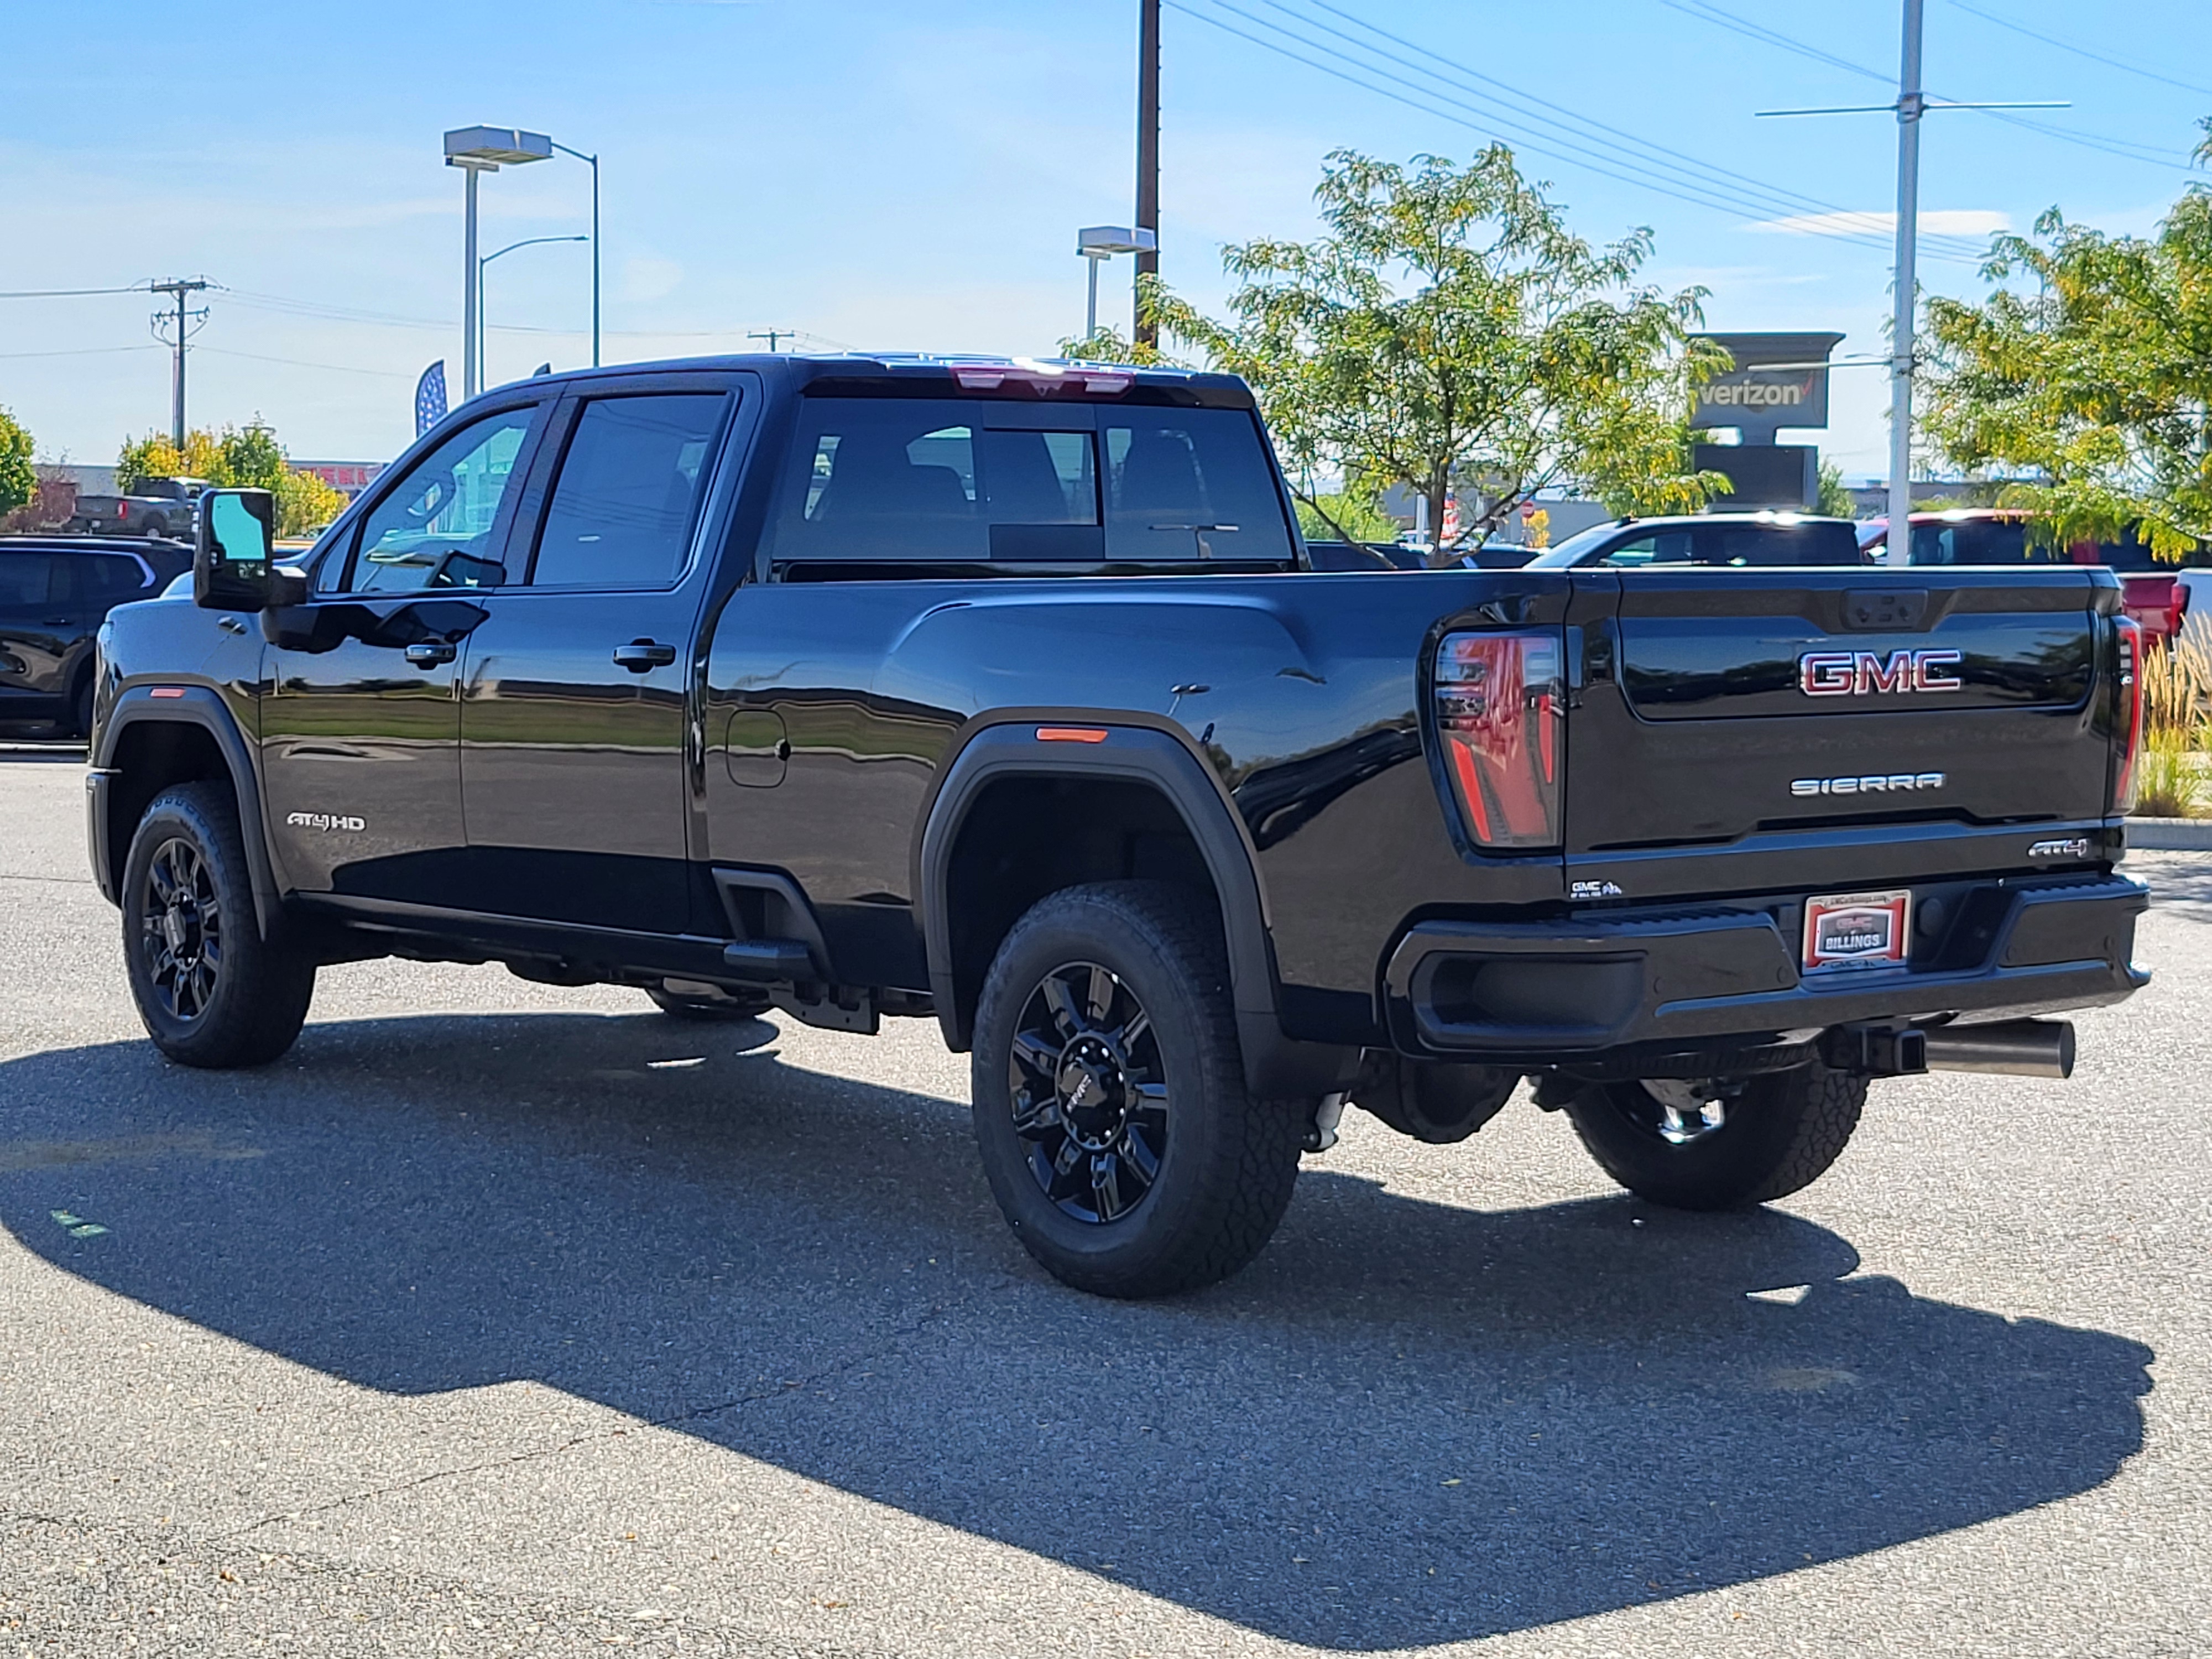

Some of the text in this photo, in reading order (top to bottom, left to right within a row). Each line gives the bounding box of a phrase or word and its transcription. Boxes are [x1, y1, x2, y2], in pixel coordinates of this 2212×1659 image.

[1699, 379, 1800, 405] verizon
[1801, 649, 1962, 697] GMC
[1790, 772, 1945, 796] SIERRA
[2028, 838, 2088, 858] AT4
[1572, 881, 1601, 892] GMC
[1836, 916, 1873, 929] GMC
[1825, 933, 1880, 951] BILLINGS
